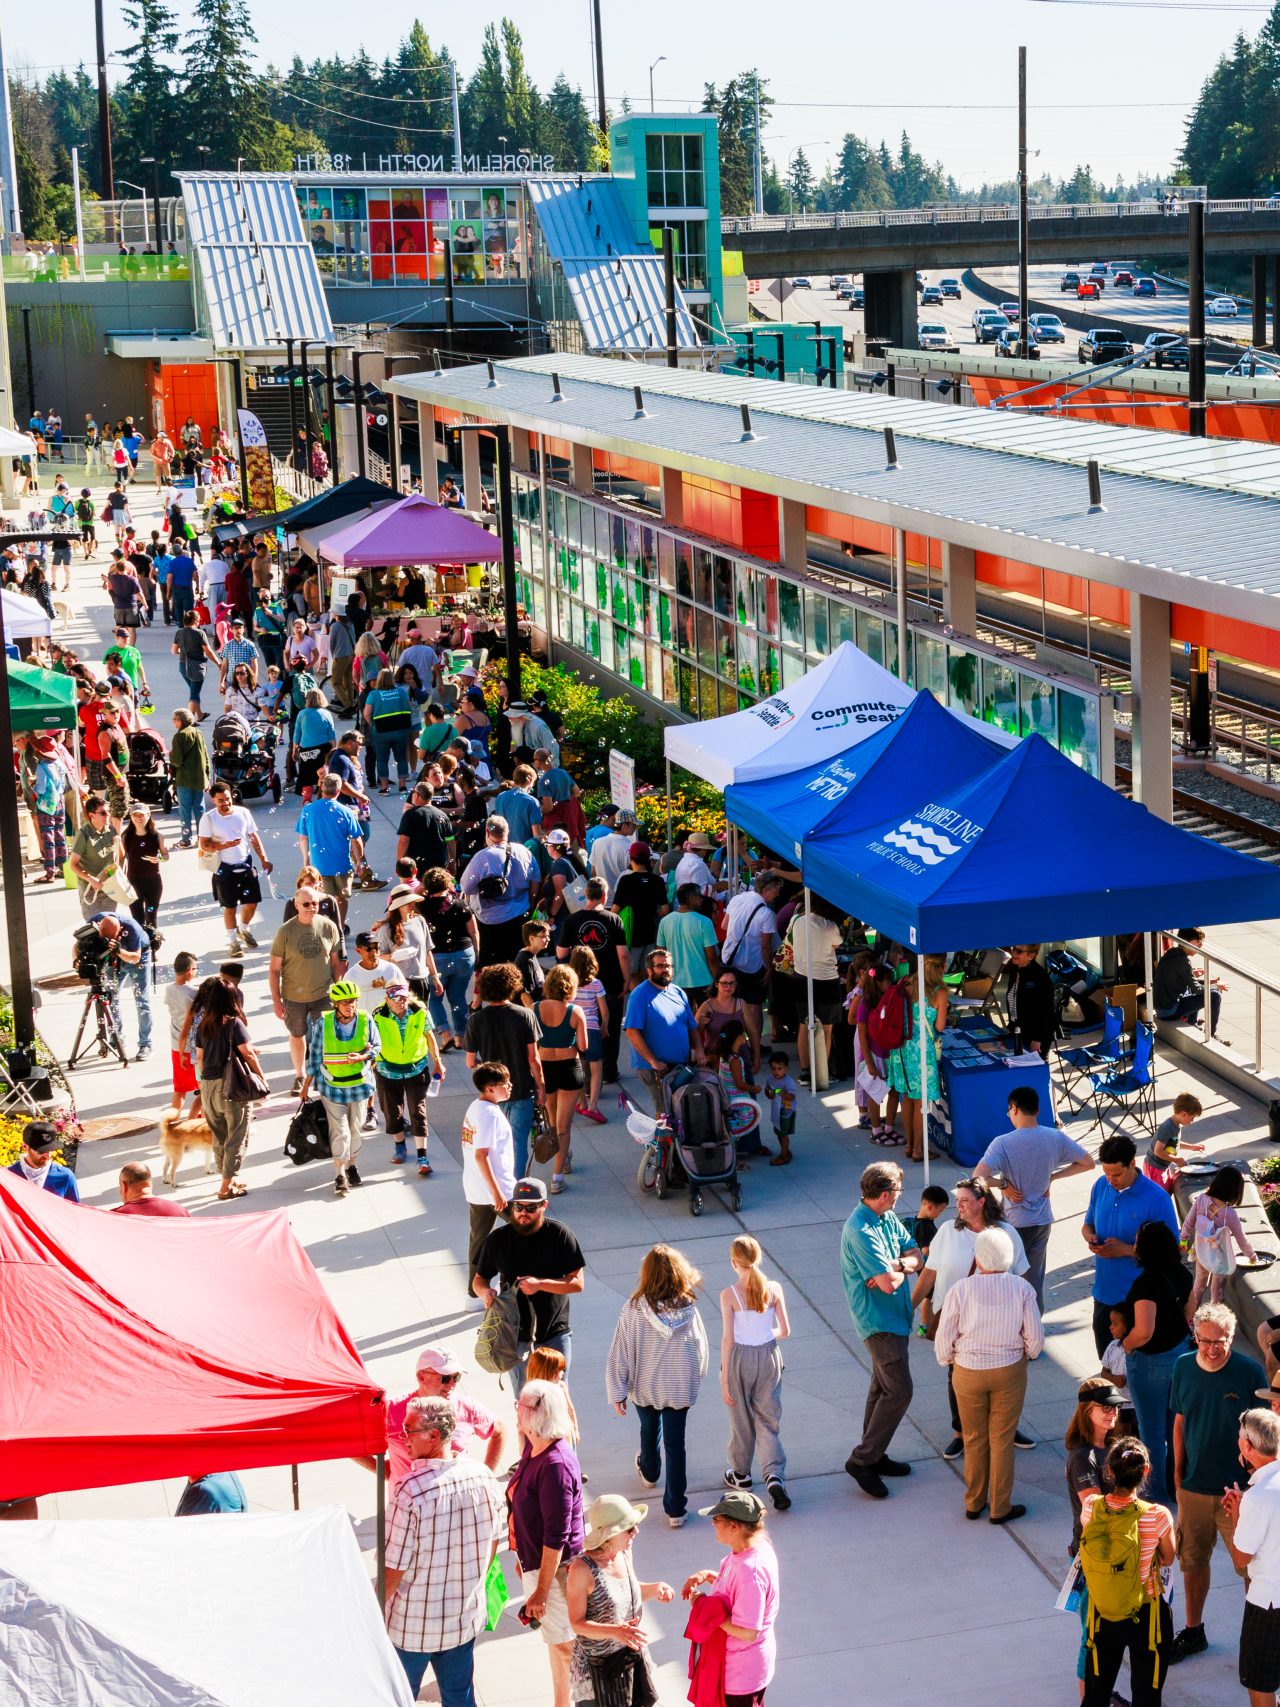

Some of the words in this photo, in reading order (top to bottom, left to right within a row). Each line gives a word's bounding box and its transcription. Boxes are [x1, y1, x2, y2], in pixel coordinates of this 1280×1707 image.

[811, 701, 897, 720] Commute
[805, 775, 848, 800] METRO
[915, 803, 984, 844] SHORELINE
[865, 841, 893, 857] PUBLIC
[887, 851, 927, 876] SCHOOLS
